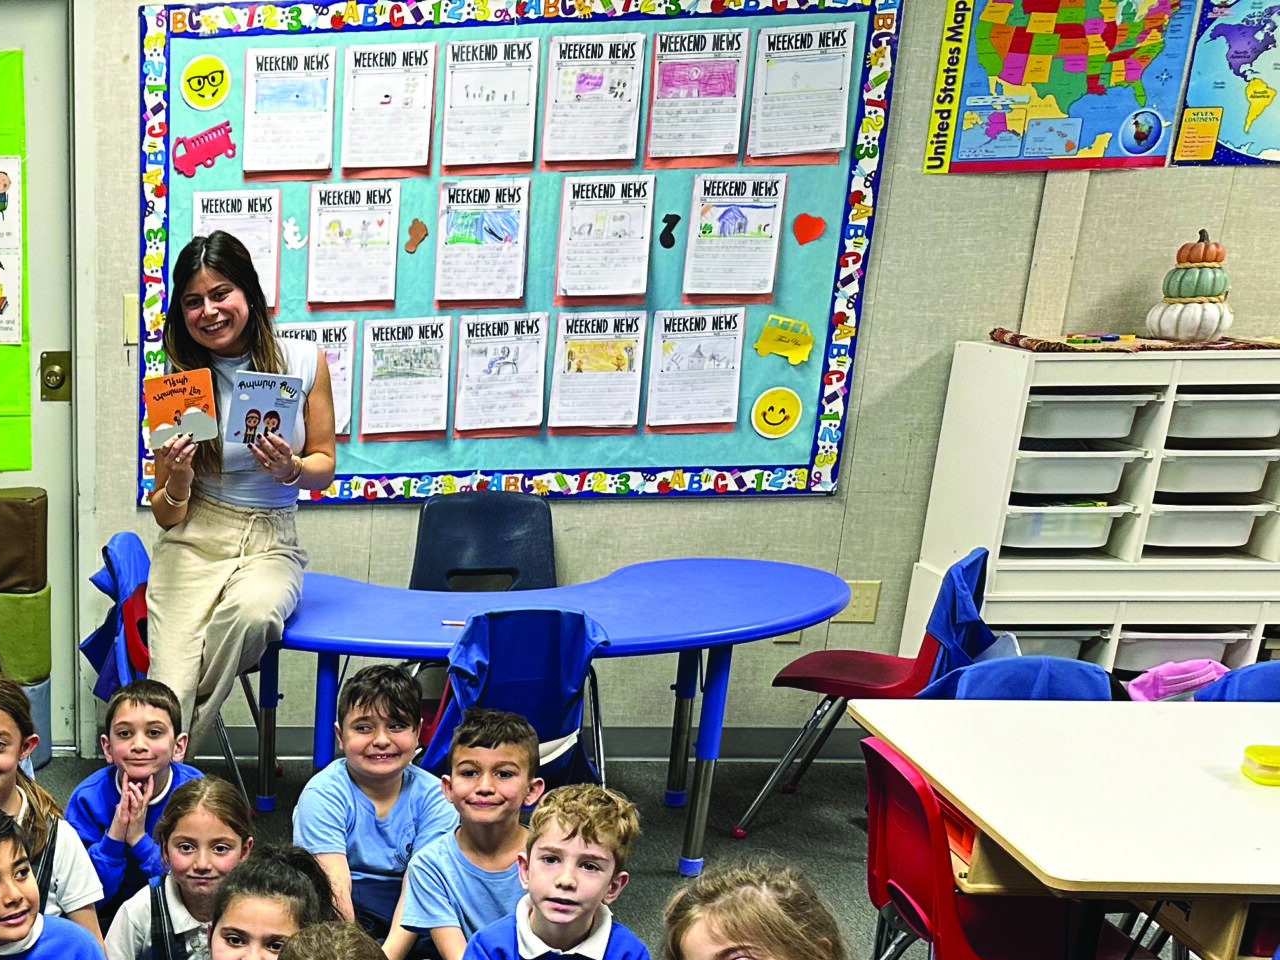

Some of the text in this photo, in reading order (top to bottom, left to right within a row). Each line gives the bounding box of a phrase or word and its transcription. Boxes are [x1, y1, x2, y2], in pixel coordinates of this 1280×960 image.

[659, 33, 741, 52] WEEKEND NEWS
[767, 30, 847, 51] WEEKEND NEWS
[354, 50, 428, 68] WEEKEND NEWS
[451, 43, 532, 62] WEEKEND NEWS
[559, 42, 636, 60] WEEKEND NEWS
[256, 54, 330, 71] WEEKEND NEWS
[926, 0, 971, 170] United States Map
[319, 188, 392, 206] WEEKEND NEWS
[448, 186, 521, 204] WEEKEND NEWS
[572, 182, 647, 200] WEEKEND NEWS
[703, 180, 779, 197] WEEKEND NEWS
[202, 197, 272, 214] WEEKEND NEWS
[372, 323, 444, 341] WEEKEND NEWS
[467, 319, 540, 338] WEEKEND NEWS
[566, 317, 639, 334] WEEKEND NEWS
[663, 314, 738, 333] WEEKEND NEWS
[322, 327, 347, 343] NEWS
